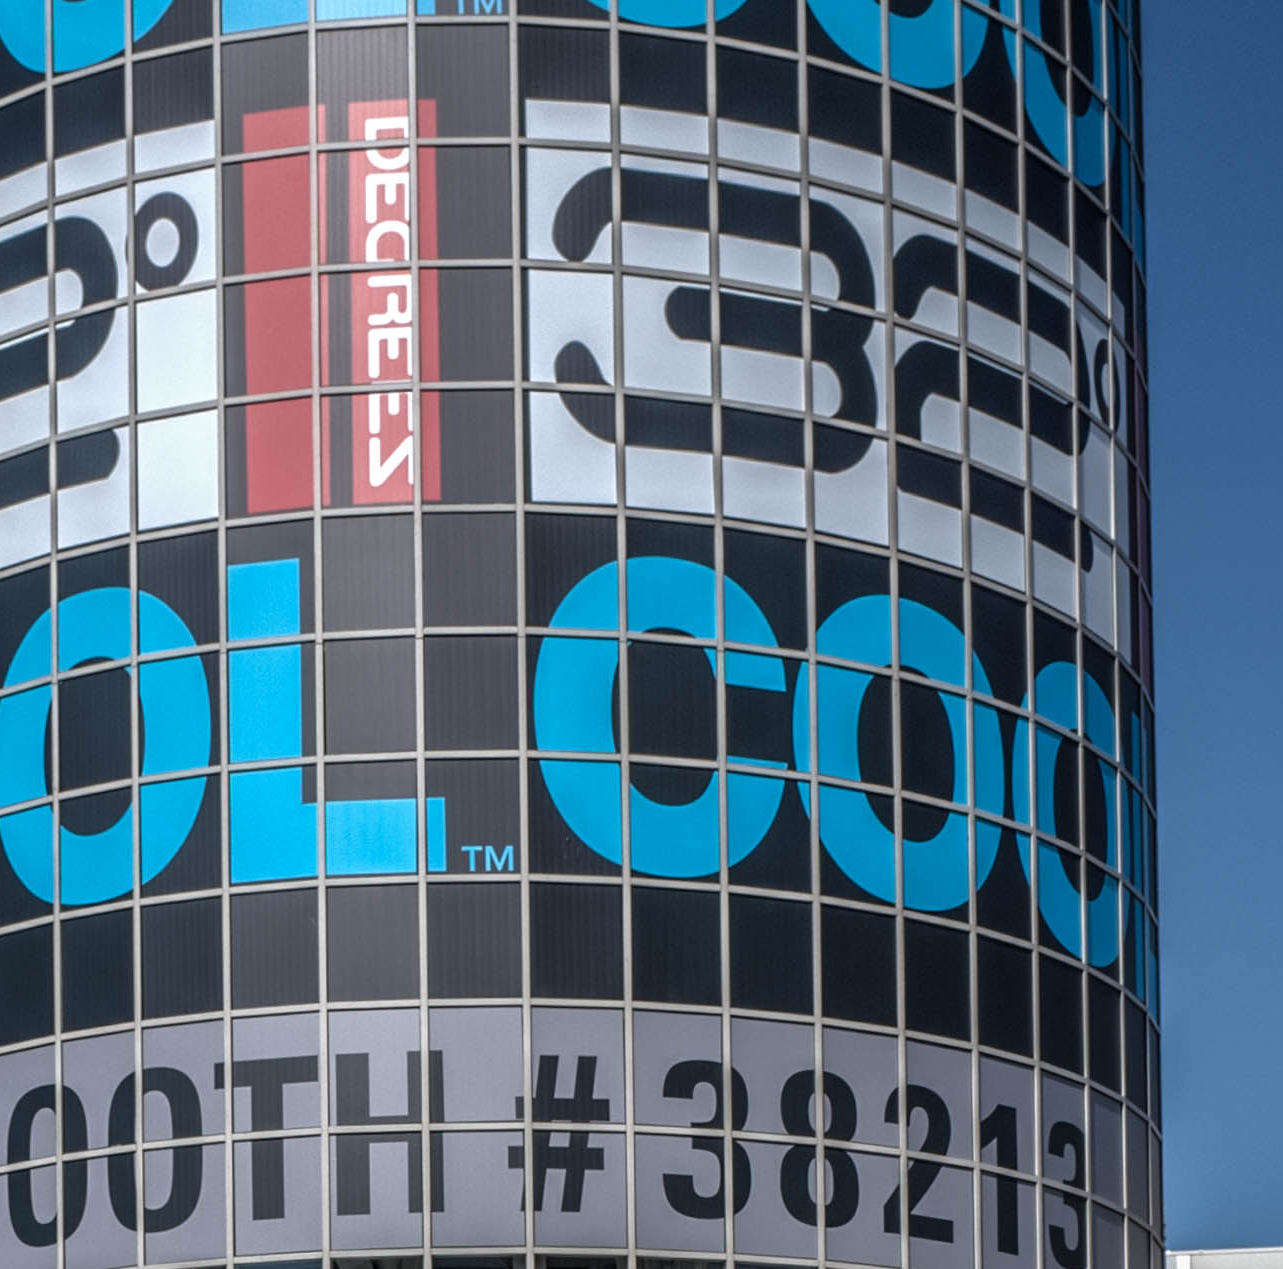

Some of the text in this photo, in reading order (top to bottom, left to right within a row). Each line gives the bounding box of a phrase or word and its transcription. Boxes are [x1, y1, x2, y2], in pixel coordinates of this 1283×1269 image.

[533, 556, 1149, 973] COO
[462, 844, 514, 872] TM
[509, 1052, 611, 1213] #
